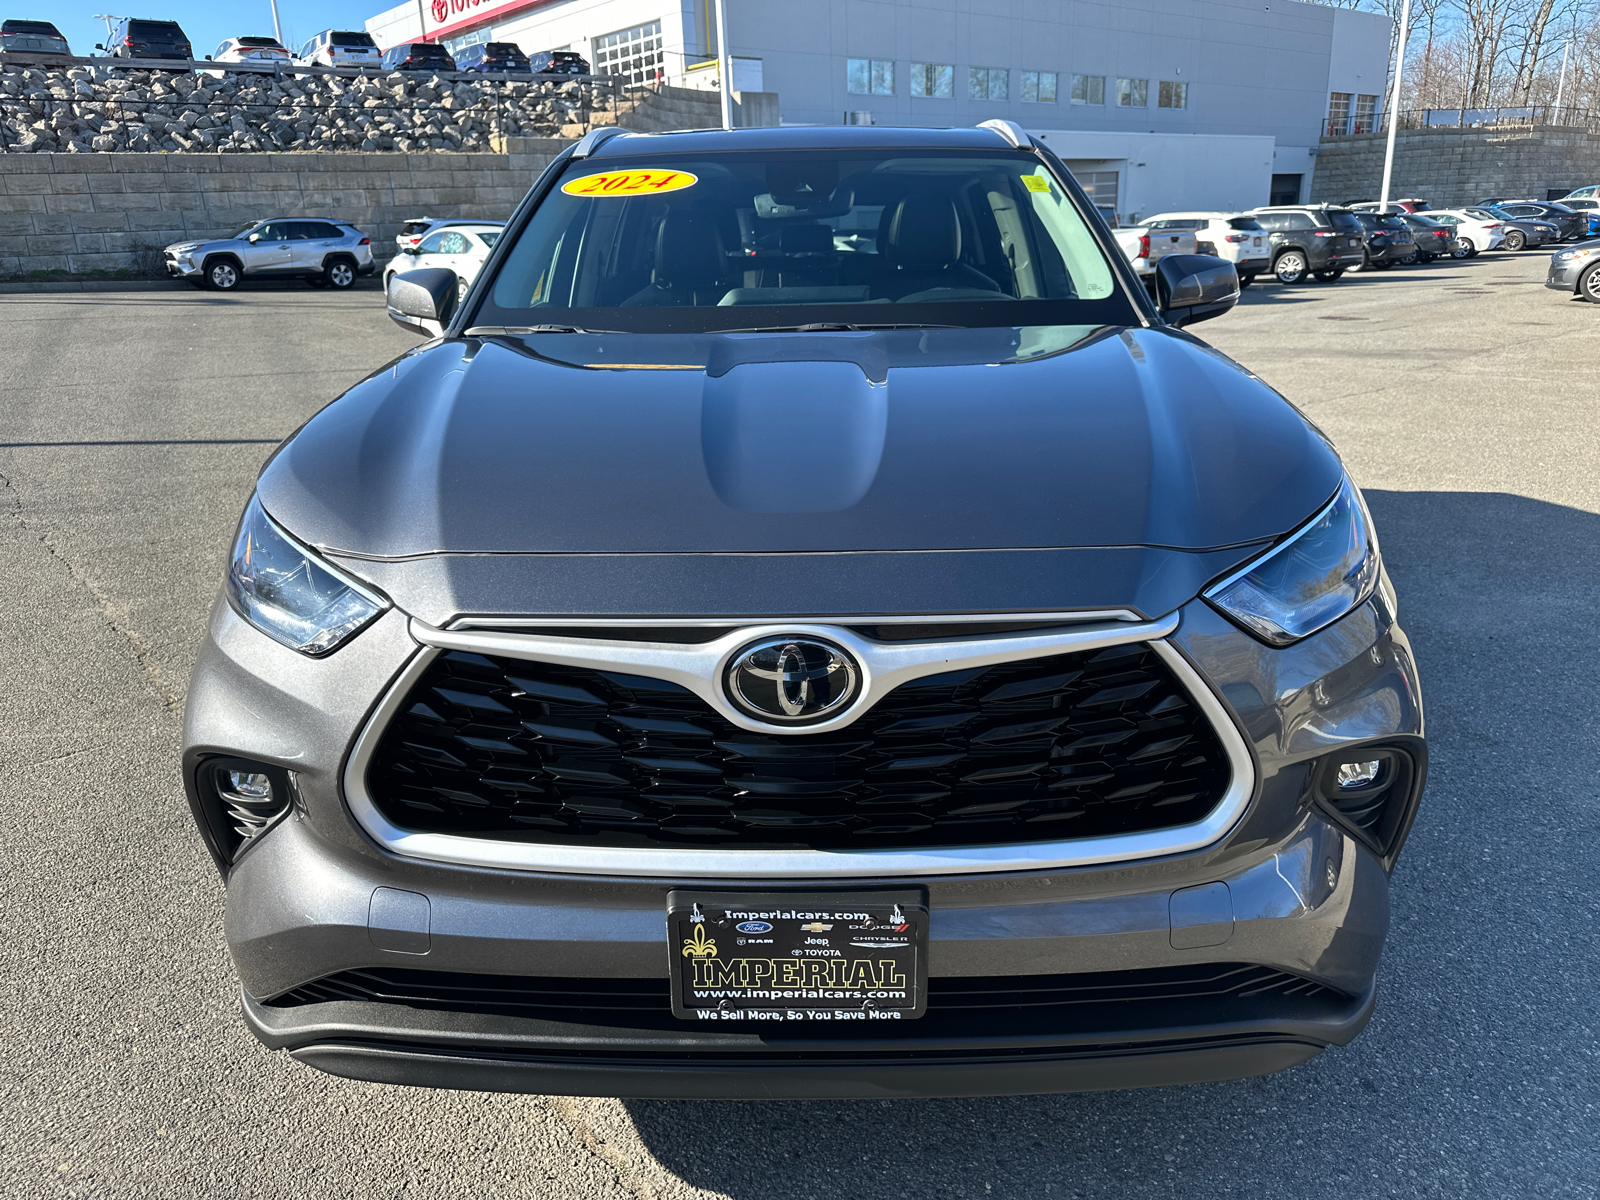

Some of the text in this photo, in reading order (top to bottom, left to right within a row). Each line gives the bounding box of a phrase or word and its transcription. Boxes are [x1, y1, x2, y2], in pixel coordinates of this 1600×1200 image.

[578, 173, 678, 193] 2024
[744, 923, 766, 932] Ford
[804, 937, 829, 946] Jeep
[692, 958, 906, 989] IMPERIAL
[693, 989, 906, 1000] www.imperialcars.com
[697, 1010, 901, 1021] We Sell More, So You Save More
